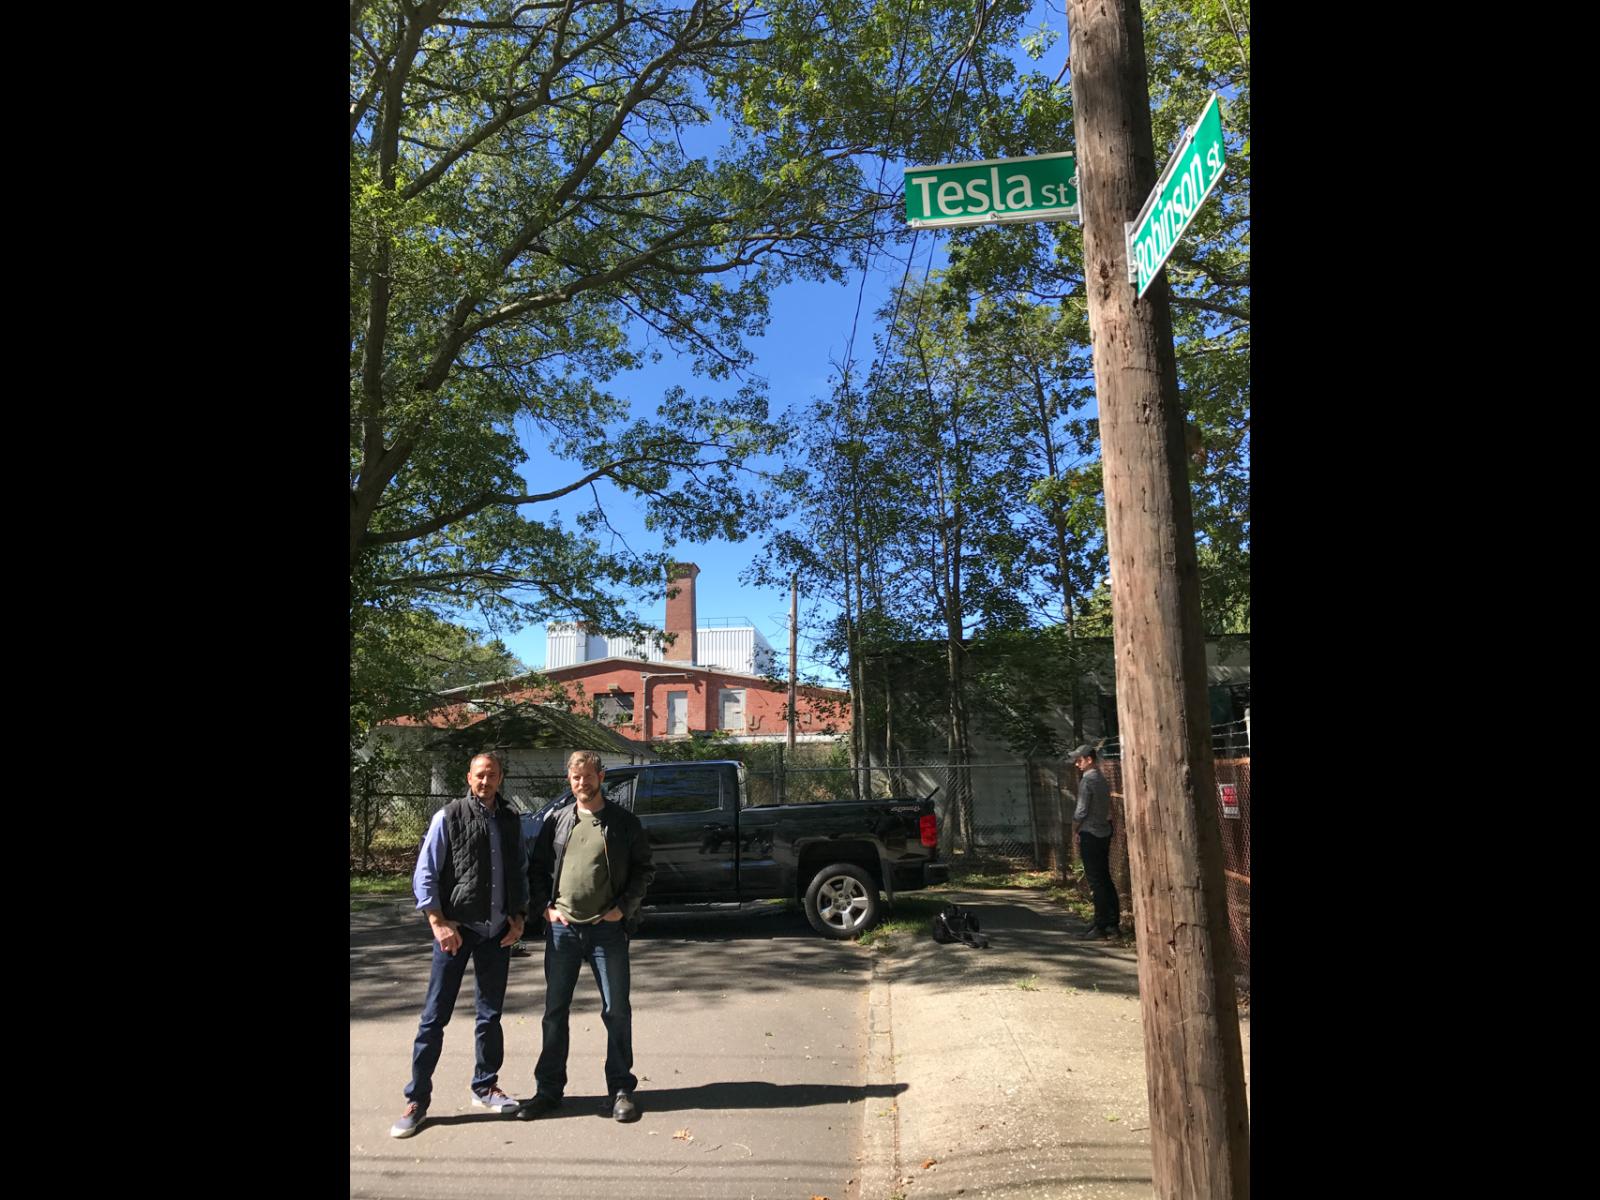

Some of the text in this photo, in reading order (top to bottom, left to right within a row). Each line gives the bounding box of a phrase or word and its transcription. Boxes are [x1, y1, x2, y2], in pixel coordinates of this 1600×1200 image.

[912, 167, 1069, 217] Tesla St
[1136, 141, 1221, 283] Robinson St
